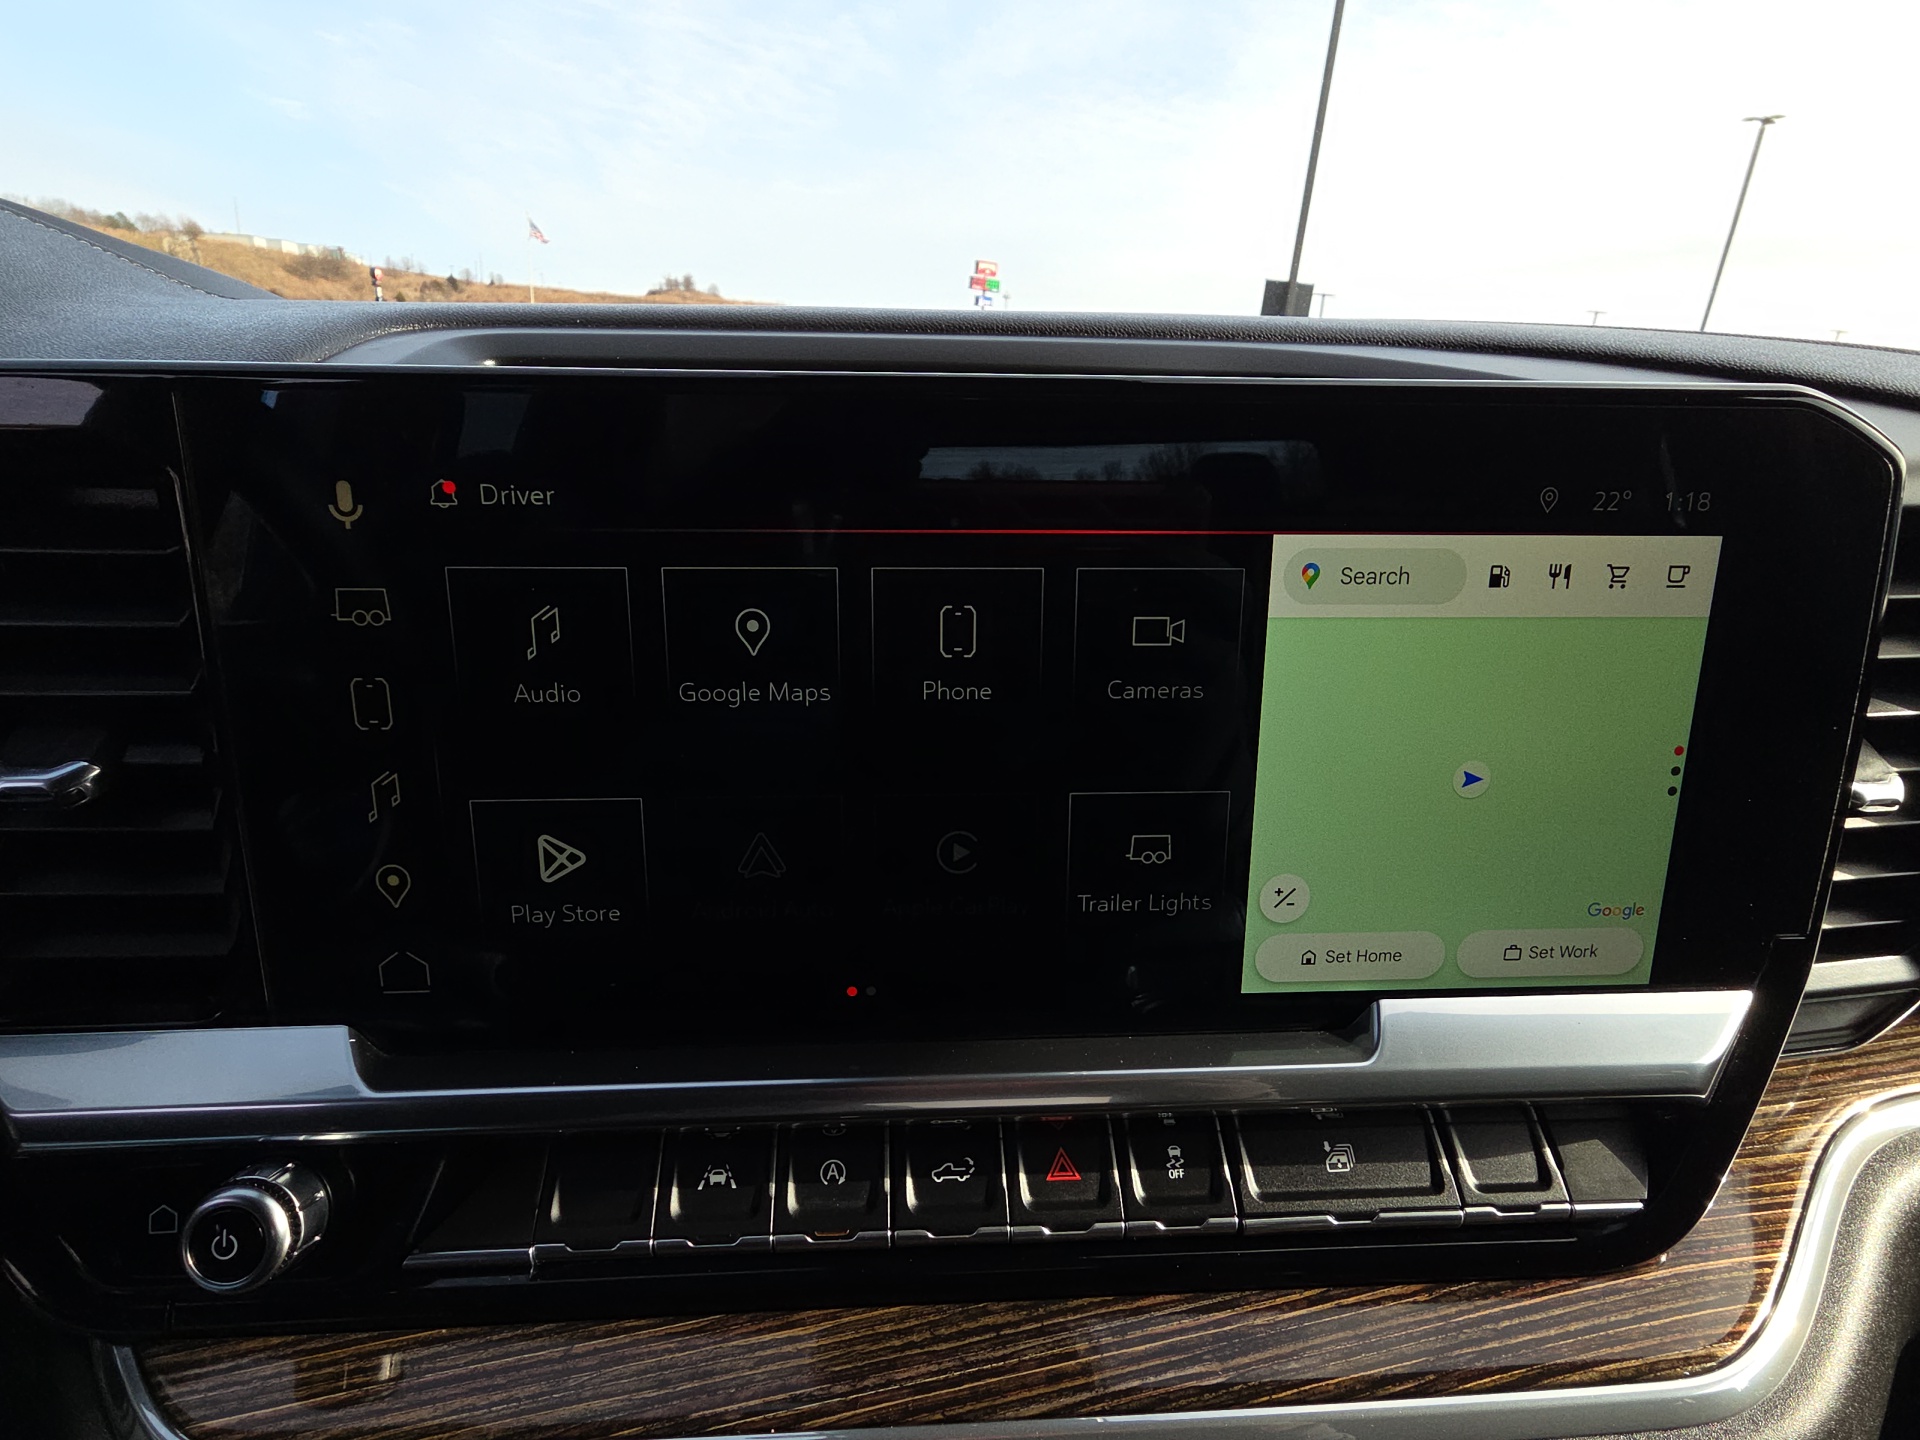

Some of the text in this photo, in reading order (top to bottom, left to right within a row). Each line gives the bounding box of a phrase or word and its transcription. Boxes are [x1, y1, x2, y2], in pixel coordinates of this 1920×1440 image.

[479, 483, 556, 506] Driver
[1664, 490, 1712, 512] 1:18
[1339, 565, 1411, 586] Search
[513, 682, 582, 704] Audio
[678, 681, 832, 709] Google Maps
[922, 680, 993, 702] Phone
[1107, 680, 1205, 700] Cameras
[510, 903, 622, 928] Play Store
[1076, 892, 1213, 917] Trailer Lights
[1587, 901, 1646, 920] Google
[1324, 947, 1403, 965] Set Home
[1527, 943, 1599, 961] Set Work
[1167, 1168, 1185, 1180] OFF
